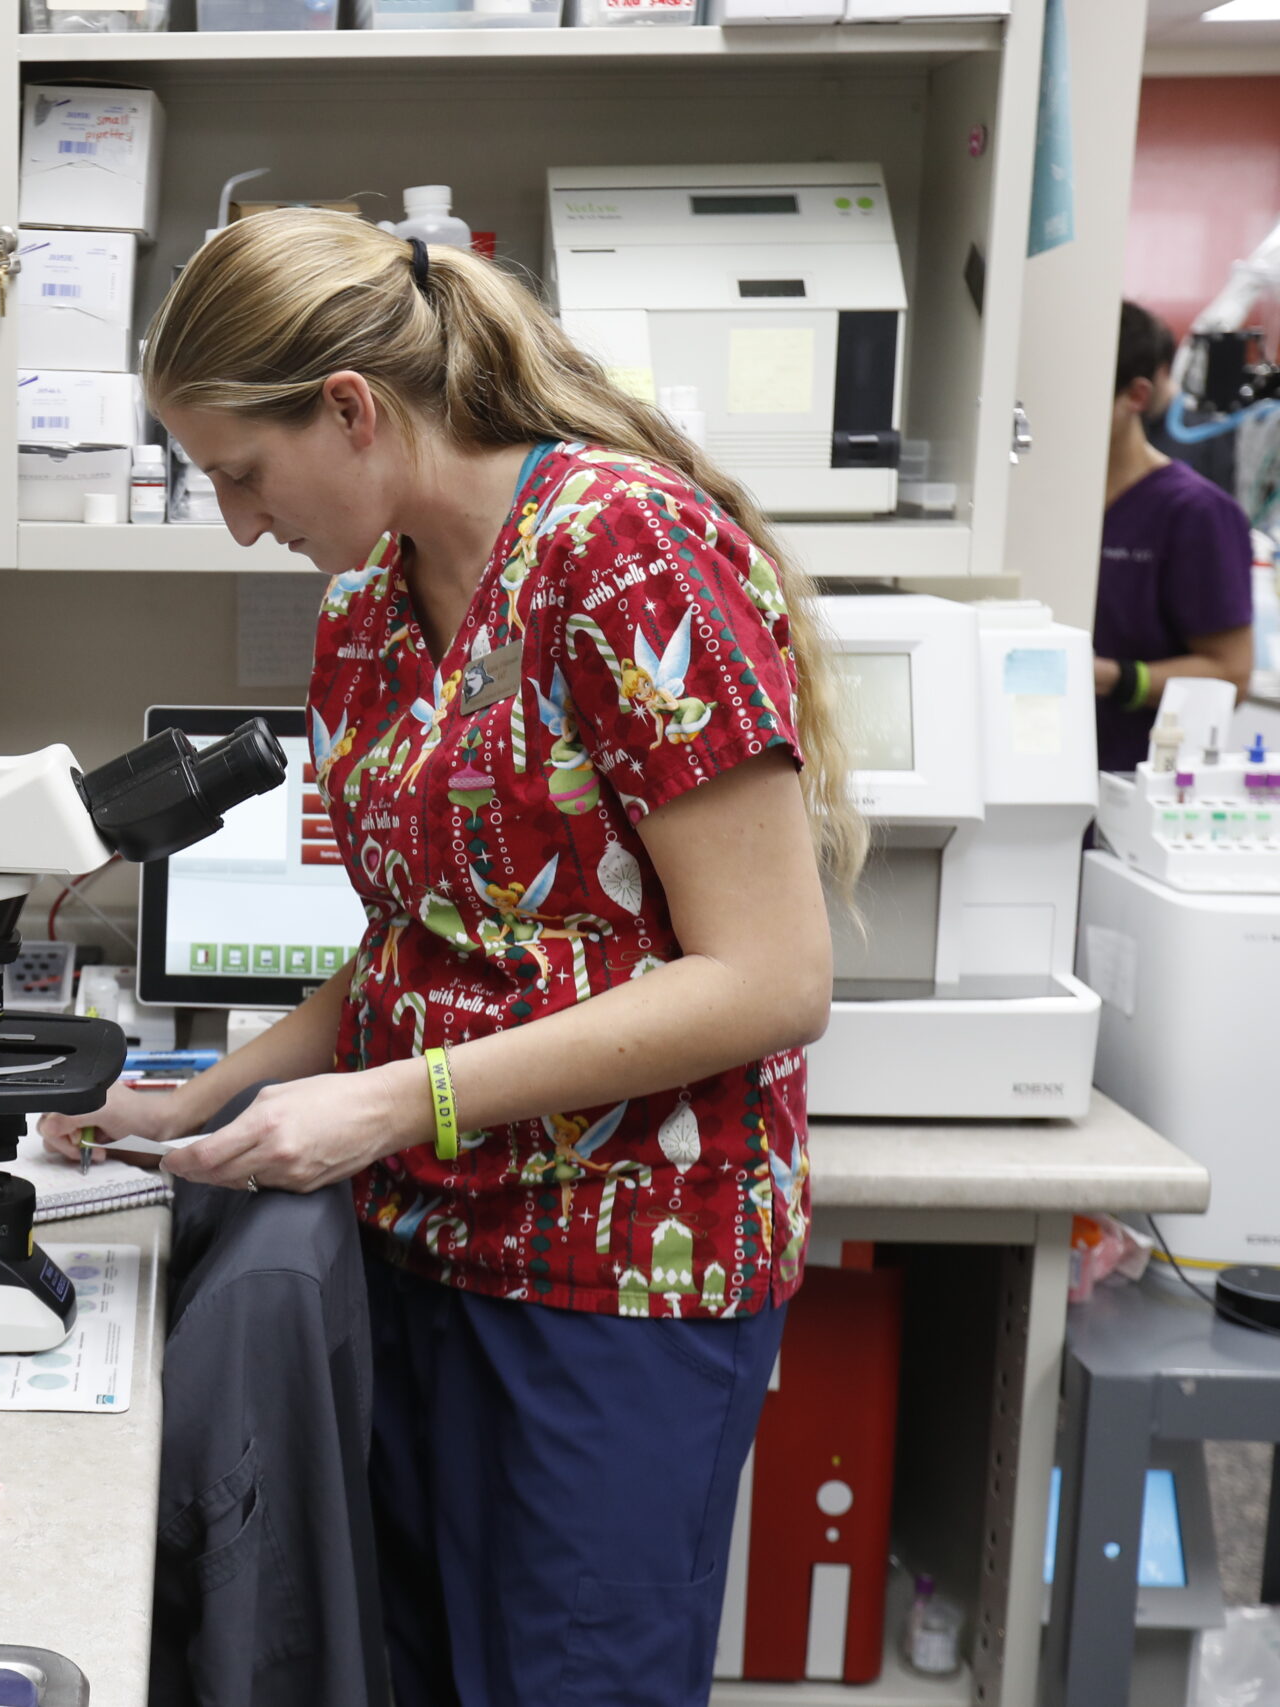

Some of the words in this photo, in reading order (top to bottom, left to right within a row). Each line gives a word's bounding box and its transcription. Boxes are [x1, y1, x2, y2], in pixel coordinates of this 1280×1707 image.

[96, 114, 130, 126] small
[85, 128, 133, 143] pipettes
[592, 567, 614, 583] I'm
[614, 552, 642, 568] there
[582, 581, 615, 611] with
[612, 563, 646, 592] bells
[649, 558, 668, 576] on
[361, 812, 375, 831] with
[375, 811, 391, 829] bells
[429, 988, 454, 1006] with
[455, 993, 485, 1013] bells
[486, 1004, 499, 1016] on
[773, 1055, 793, 1080] bells
[504, 1235, 518, 1250] on
